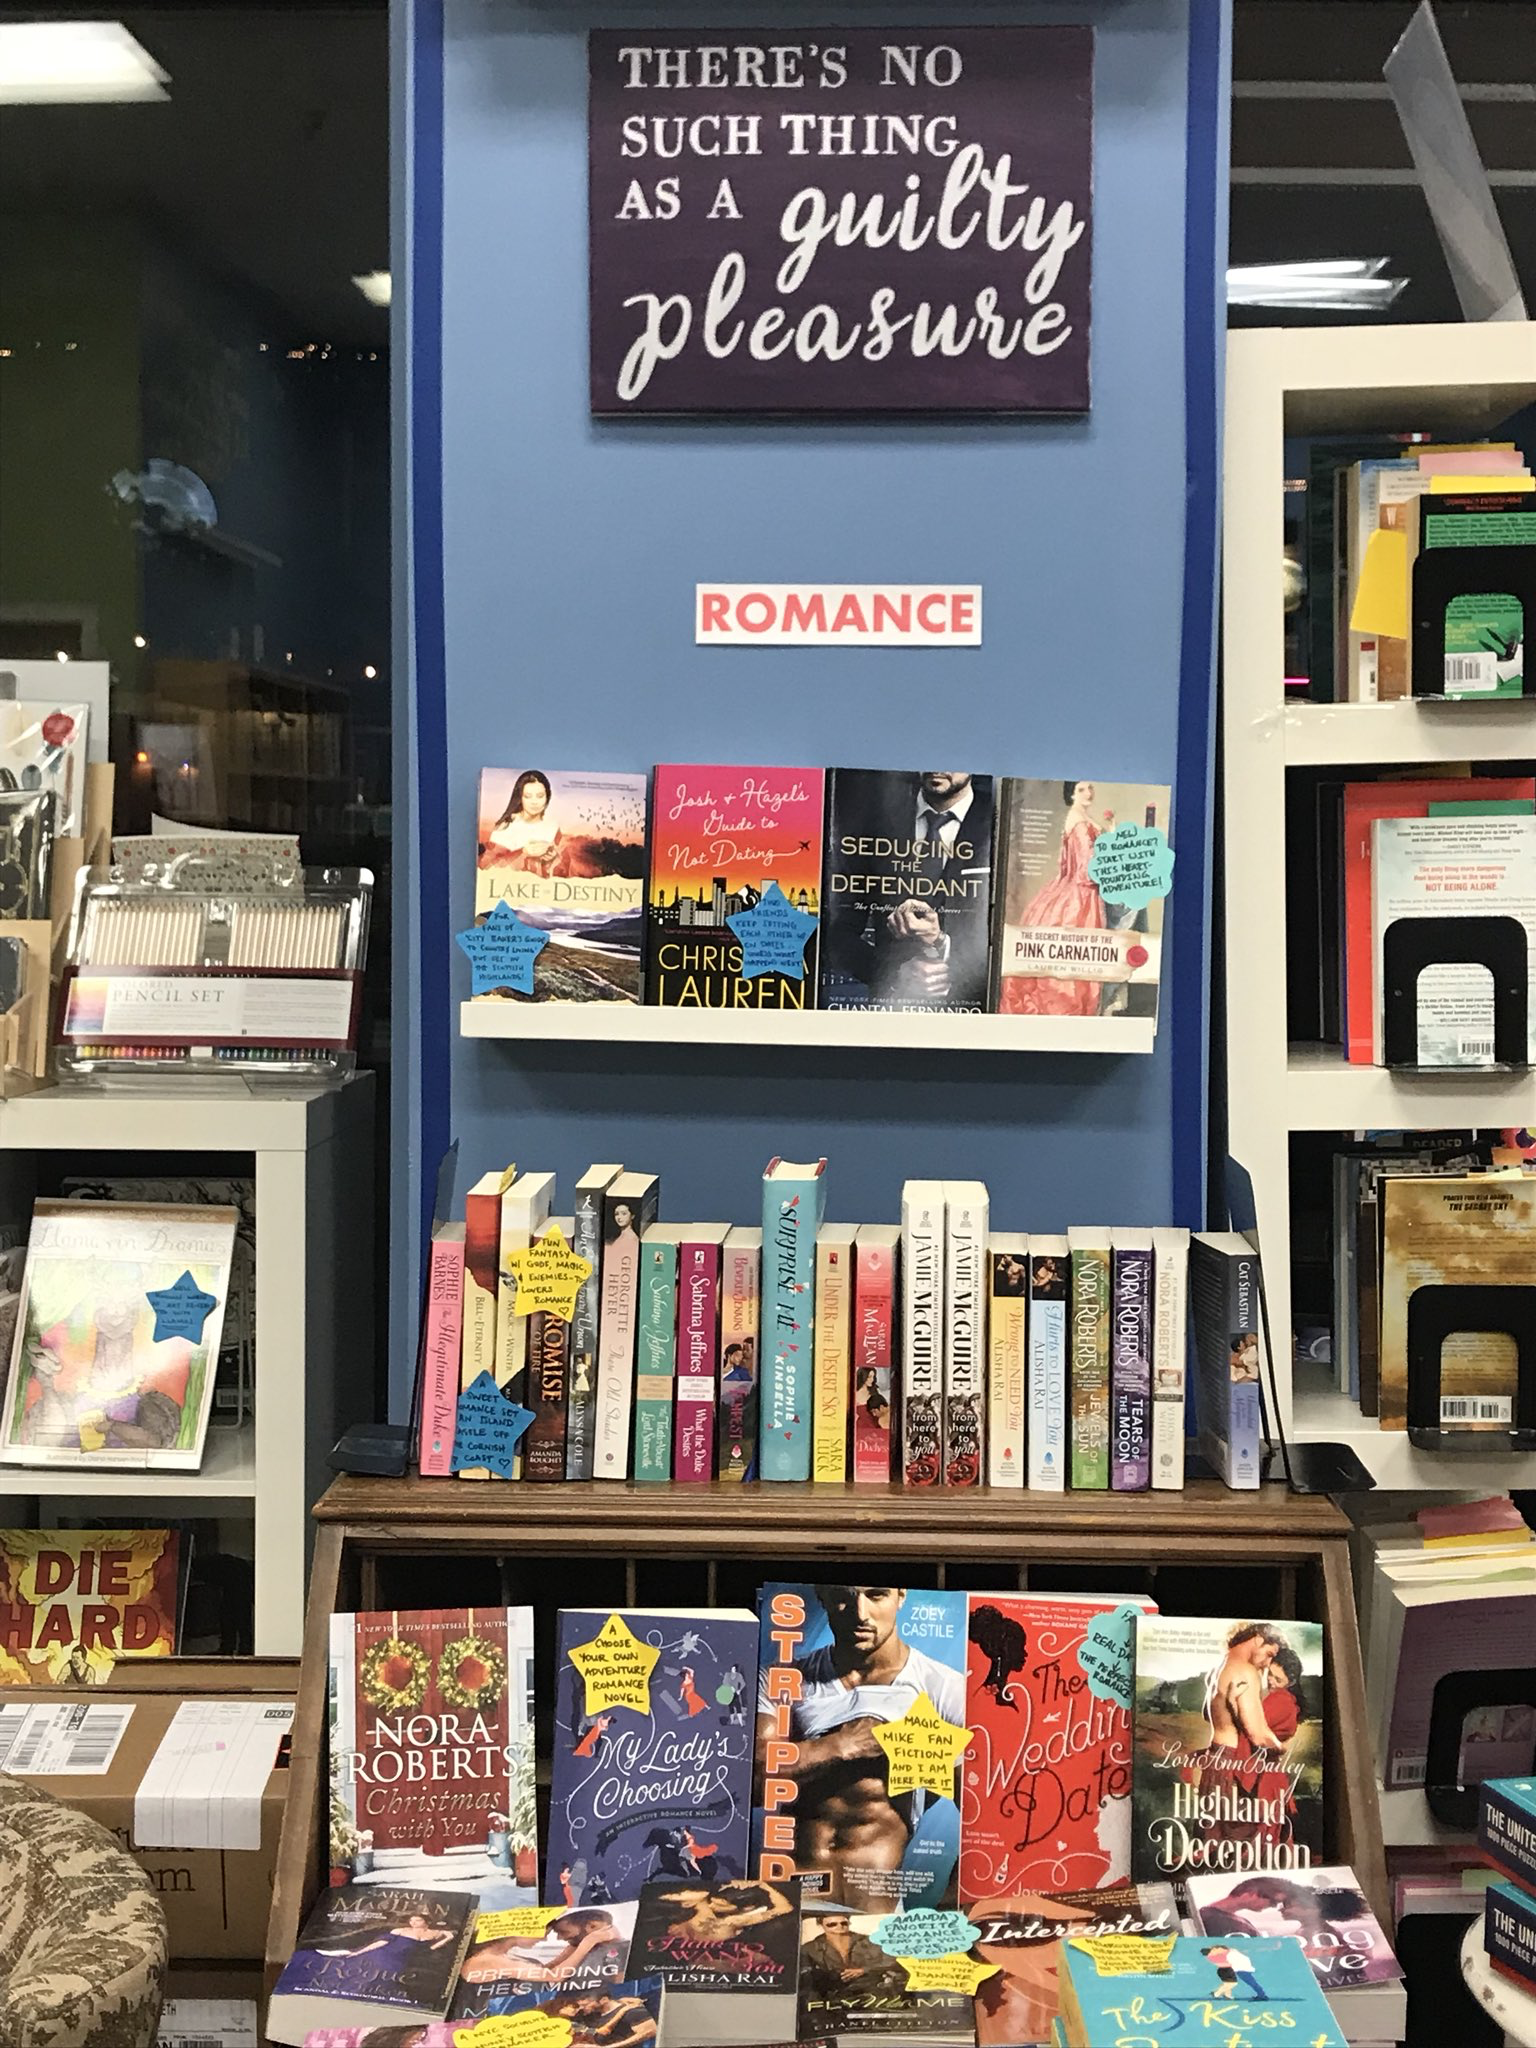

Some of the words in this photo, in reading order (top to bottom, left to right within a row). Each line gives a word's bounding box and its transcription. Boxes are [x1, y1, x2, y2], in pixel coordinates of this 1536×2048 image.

[618, 45, 848, 89] THERE'S
[881, 45, 963, 87] NO
[620, 115, 763, 158] SUCH
[780, 114, 961, 156] THING
[615, 177, 680, 220] AS
[706, 178, 744, 220] A
[775, 144, 1085, 304] guilty
[616, 252, 1072, 401] pleasure
[702, 592, 974, 633] ROMANCE
[669, 783, 717, 819] Josh
[739, 778, 810, 809] Hazel's
[703, 810, 755, 837] Guide
[761, 817, 778, 831] to
[1115, 826, 1138, 841] NEW
[668, 844, 709, 870] Not
[711, 841, 777, 868] Dating
[840, 836, 974, 860] SEDUCING
[1096, 842, 1107, 852] TO
[1111, 837, 1159, 851] ROMANCE?
[1096, 854, 1126, 865] START
[1128, 850, 1156, 860] WITH
[891, 860, 923, 873] THE
[1093, 865, 1118, 877] THIS
[1100, 871, 1150, 886] POUNDING
[488, 879, 541, 900] LAKE
[553, 881, 638, 905] DESTINY
[831, 873, 983, 898] DEFENDANT
[1102, 876, 1164, 894] ADVENTURE!
[1425, 883, 1441, 892] NOT
[1444, 882, 1468, 891] BEING
[1021, 931, 1034, 940] THE
[1035, 932, 1060, 942] SECRET
[1061, 933, 1089, 943] HISTORY
[1015, 942, 1046, 959] PINK
[1048, 943, 1119, 963] CARNATION
[112, 990, 183, 1002] PENCIL
[190, 989, 225, 1003] SET
[529, 1249, 570, 1259] FANTASY
[541, 1238, 560, 1247] FUN
[777, 1203, 799, 1297] SURPRISE
[911, 1233, 932, 1288] JAMIE
[952, 1233, 972, 1288] JAMIE
[1238, 1262, 1250, 1280] CAT
[434, 1255, 446, 1300] BARNES
[446, 1255, 458, 1301] SOPHIE
[521, 1285, 553, 1294] LOVERS
[1078, 1259, 1100, 1301] NORA
[1119, 1259, 1143, 1301] NORA
[1159, 1271, 1171, 1305] NORA
[534, 1296, 573, 1304] ROMANCE
[607, 1273, 619, 1316] HEYER
[617, 1255, 632, 1334] GEORGETTE
[690, 1274, 711, 1328] Sabrina
[823, 1276, 842, 1321] UNDER
[1239, 1280, 1251, 1329] SEBASTIAN
[776, 1302, 796, 1333] ME
[823, 1324, 835, 1342] THE
[877, 1322, 887, 1351] SARAH
[912, 1290, 932, 1391] McGUIRE
[953, 1290, 972, 1391] McGUIRE
[1074, 1304, 1100, 1369] ROBERTS
[1116, 1304, 1142, 1370] ROBERTS
[1158, 1309, 1170, 1367] ROBERTS
[541, 1313, 565, 1401] ROMISE
[688, 1321, 709, 1373] Jeffries
[821, 1347, 841, 1394] DESERT
[1033, 1340, 1046, 1385] ALISHA
[466, 1392, 500, 1403] SWEET
[773, 1354, 785, 1429] KINSELLA
[784, 1364, 797, 1420] SOPHIE
[1119, 1394, 1128, 1413] THE
[501, 1407, 519, 1418] SET
[819, 1395, 837, 1420] SKY
[912, 1411, 937, 1423] from
[952, 1411, 978, 1423] from
[1131, 1399, 1144, 1443] TEARS
[912, 1424, 936, 1434] here
[952, 1424, 976, 1434] here
[1089, 1394, 1101, 1449] JEWELS
[467, 1442, 506, 1453] CORNISH
[918, 1434, 930, 1445] to
[958, 1434, 970, 1445] to
[1078, 1426, 1089, 1454] SUN
[1118, 1416, 1131, 1464] MOON
[1132, 1445, 1141, 1461] OF
[464, 1454, 495, 1463] COAST
[816, 1437, 829, 1473] LUCK
[828, 1438, 844, 1474] SARA
[913, 1445, 936, 1462] you
[954, 1445, 976, 1462] you
[34, 1550, 133, 1596] DIE
[0, 1603, 162, 1651] HARD
[910, 1606, 947, 1622] ZOEY
[594, 1638, 632, 1648] CHOOSE
[609, 1624, 617, 1635] A
[901, 1622, 955, 1639] CASTILE
[1092, 1632, 1117, 1654] REAL
[579, 1653, 609, 1663] YOUR
[613, 1652, 639, 1661] OWN
[584, 1666, 647, 1676] ADVENTURE
[1080, 1651, 1098, 1666] THE
[592, 1679, 645, 1691] ROMANCE
[1032, 1659, 1087, 1704] The
[604, 1693, 645, 1704] NOVEL
[373, 1713, 494, 1749] NORA
[904, 1716, 941, 1729] MAGIC
[765, 1593, 806, 1882] STRIPPED
[883, 1732, 914, 1744] MIKE
[928, 1734, 953, 1745] FAN
[965, 1696, 1133, 1800] Weddin
[347, 1744, 519, 1785] ROBERTS
[600, 1731, 649, 1771] My
[640, 1731, 731, 1774] Lady's
[894, 1747, 953, 1759] FICTION-
[1152, 1739, 1197, 1770] Lori
[1196, 1744, 1243, 1773] Ann
[1242, 1746, 1308, 1791] Bailey
[890, 1776, 914, 1785] HERE
[919, 1776, 937, 1785] FOR
[941, 1779, 952, 1787] IT
[892, 1763, 913, 1772] AND
[918, 1764, 924, 1773] I
[929, 1764, 947, 1774] AM
[365, 1786, 502, 1816] Christmas
[593, 1765, 727, 1819] Choosing
[1001, 1752, 1132, 1852] Date
[1171, 1782, 1288, 1830] Highland
[388, 1816, 434, 1840] with
[440, 1819, 477, 1839] You
[1486, 1802, 1505, 1829] THE
[1507, 1817, 1536, 1853] UNITE
[1147, 1815, 1312, 1874] Deception
[1500, 1838, 1517, 1857] PIECE
[979, 1908, 1171, 1945] Intercepted
[1493, 1907, 1515, 1938] THE
[1511, 1942, 1531, 1964] PIECE
[466, 1964, 619, 1983] PRETENDING
[737, 1973, 776, 1984] RAI
[476, 1982, 532, 1997] HE'S
[807, 1998, 860, 2012] FLY
[916, 1996, 965, 2009] ME
[1101, 1996, 1171, 2031] The
[1188, 2000, 1297, 2030] Kiss
